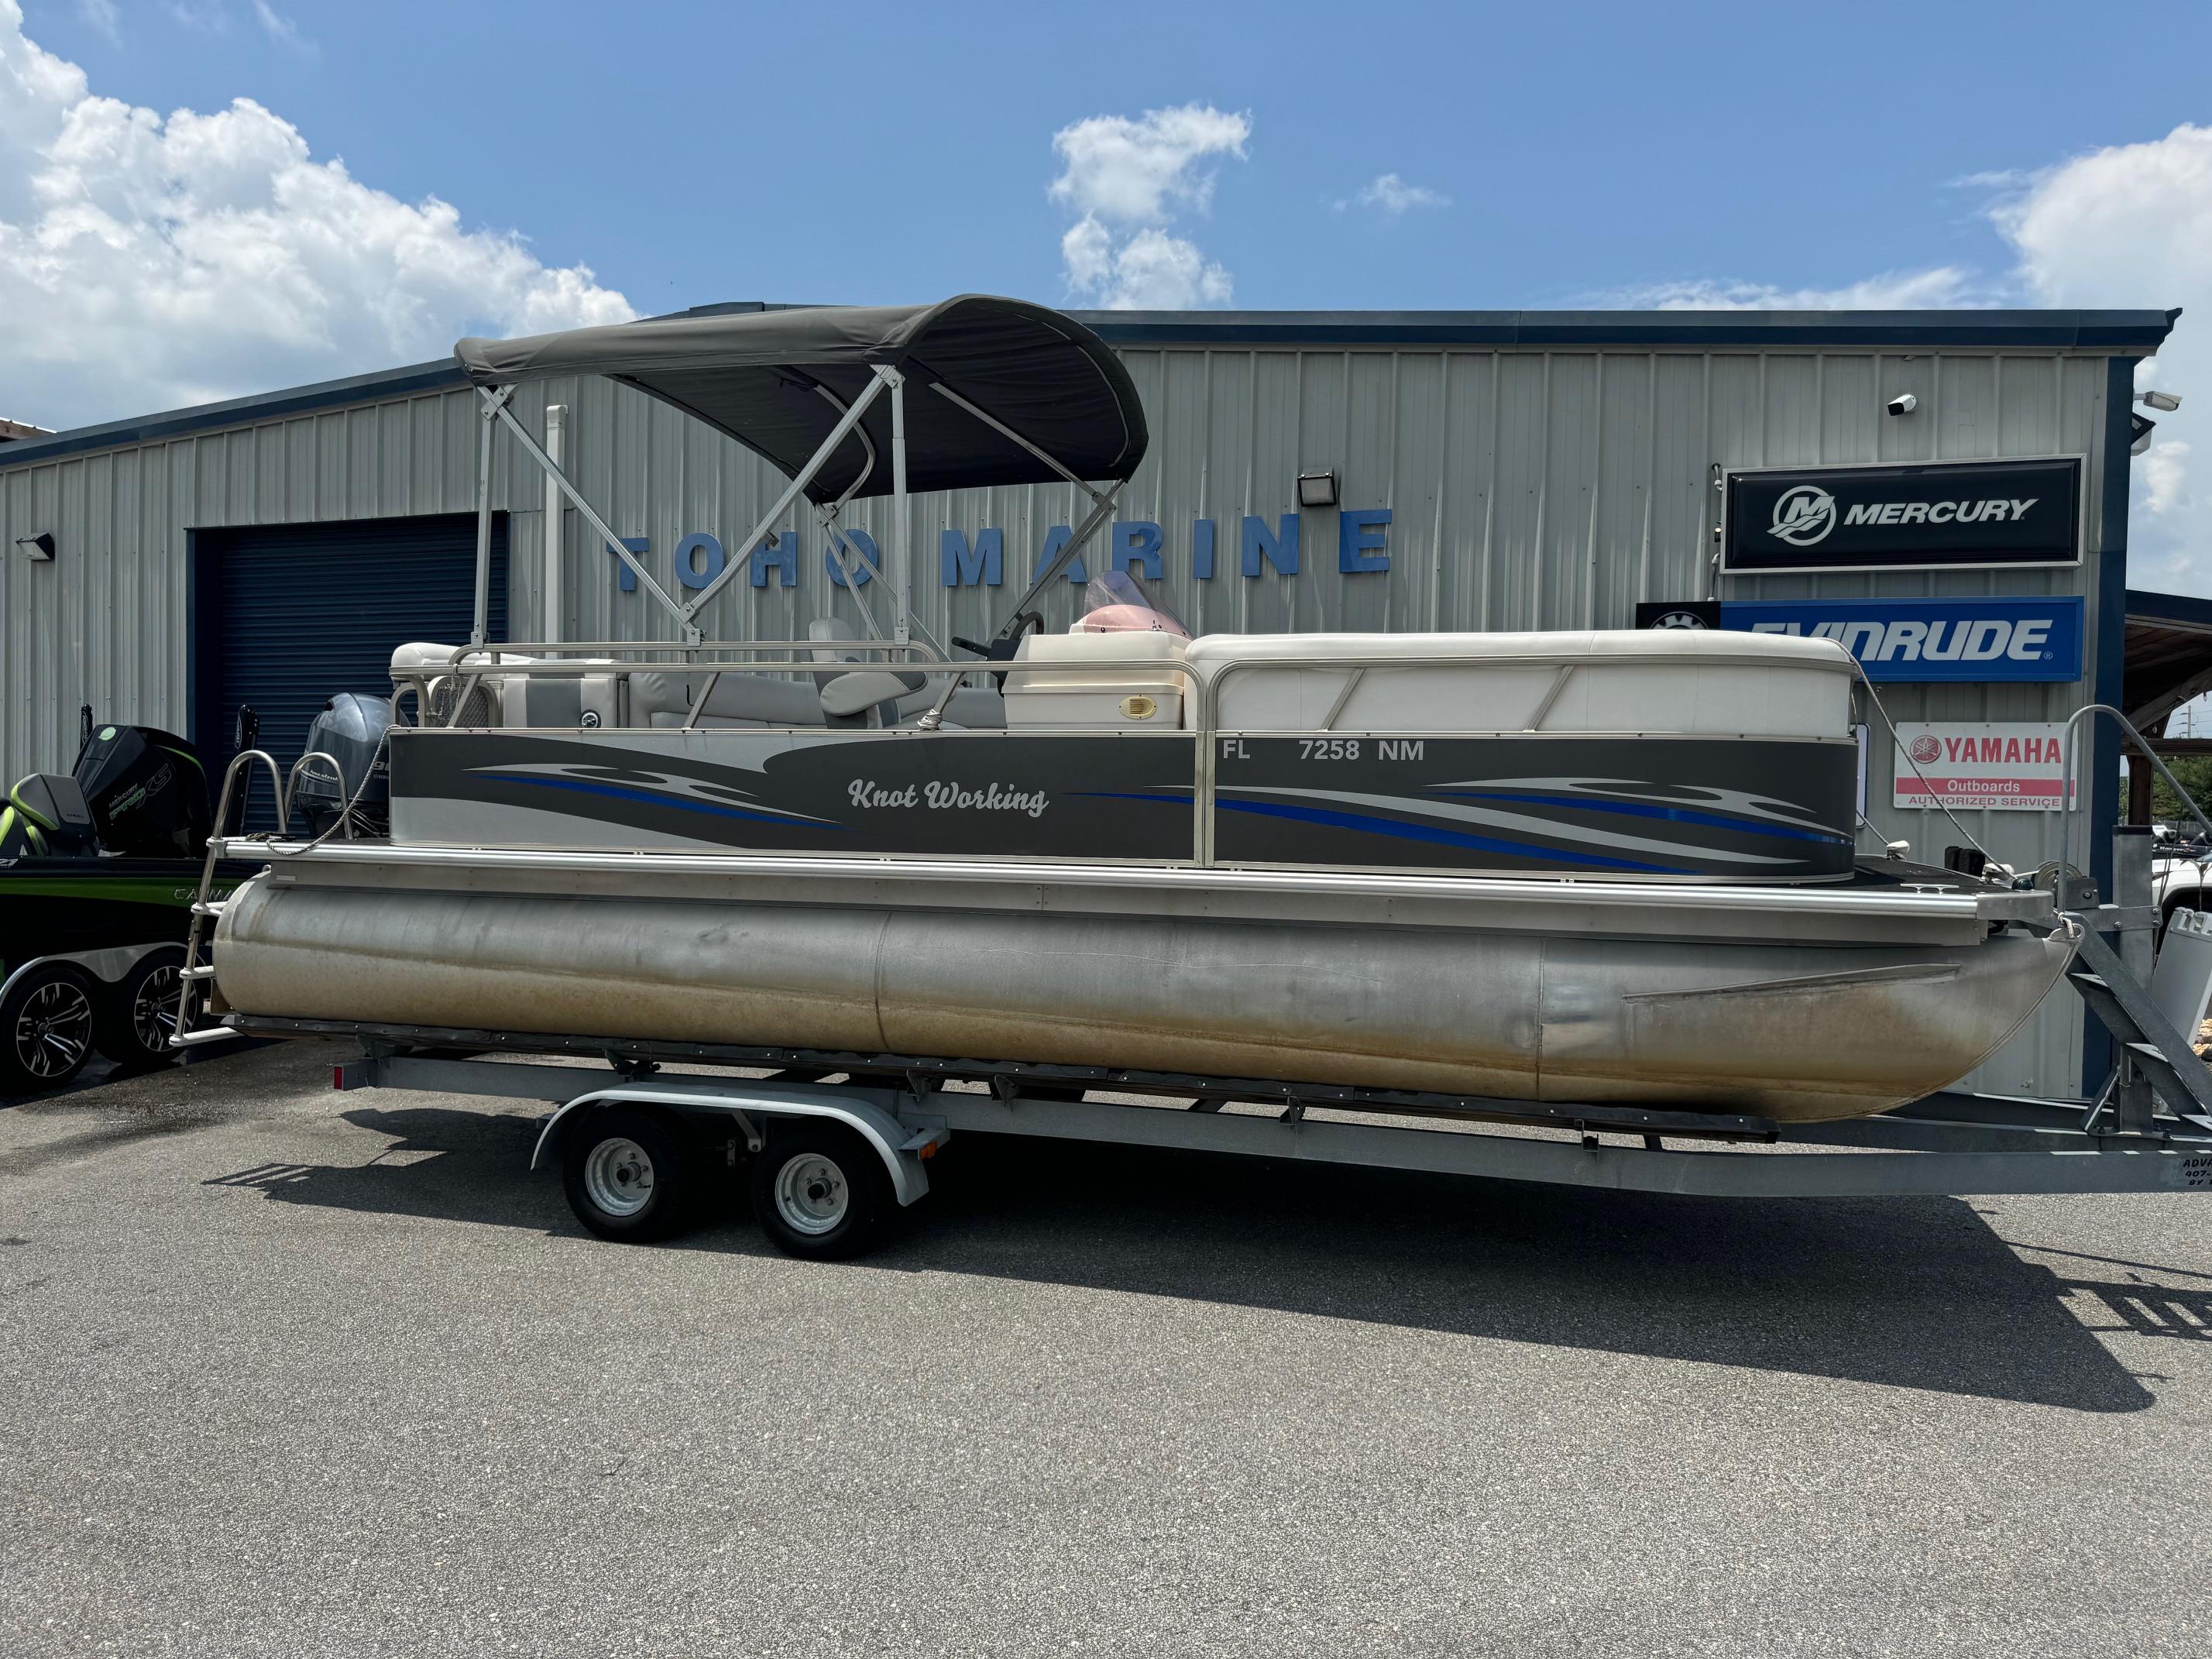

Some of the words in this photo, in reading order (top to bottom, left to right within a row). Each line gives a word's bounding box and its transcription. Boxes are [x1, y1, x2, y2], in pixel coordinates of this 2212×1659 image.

[1843, 498, 2039, 526] MERCURY
[606, 528, 878, 591] TOHO
[940, 508, 1392, 587] MARINE
[1752, 620, 2053, 661] NRUDE
[1223, 740, 1251, 759] FL
[1299, 740, 1360, 760] 7258
[1378, 740, 1424, 761] NM
[1945, 737, 2062, 764] YAMAHA
[848, 778, 919, 809] Knot
[924, 781, 1049, 818] Working
[1947, 779, 2020, 792] Outboards
[1908, 796, 1996, 805] AUTHORIZED
